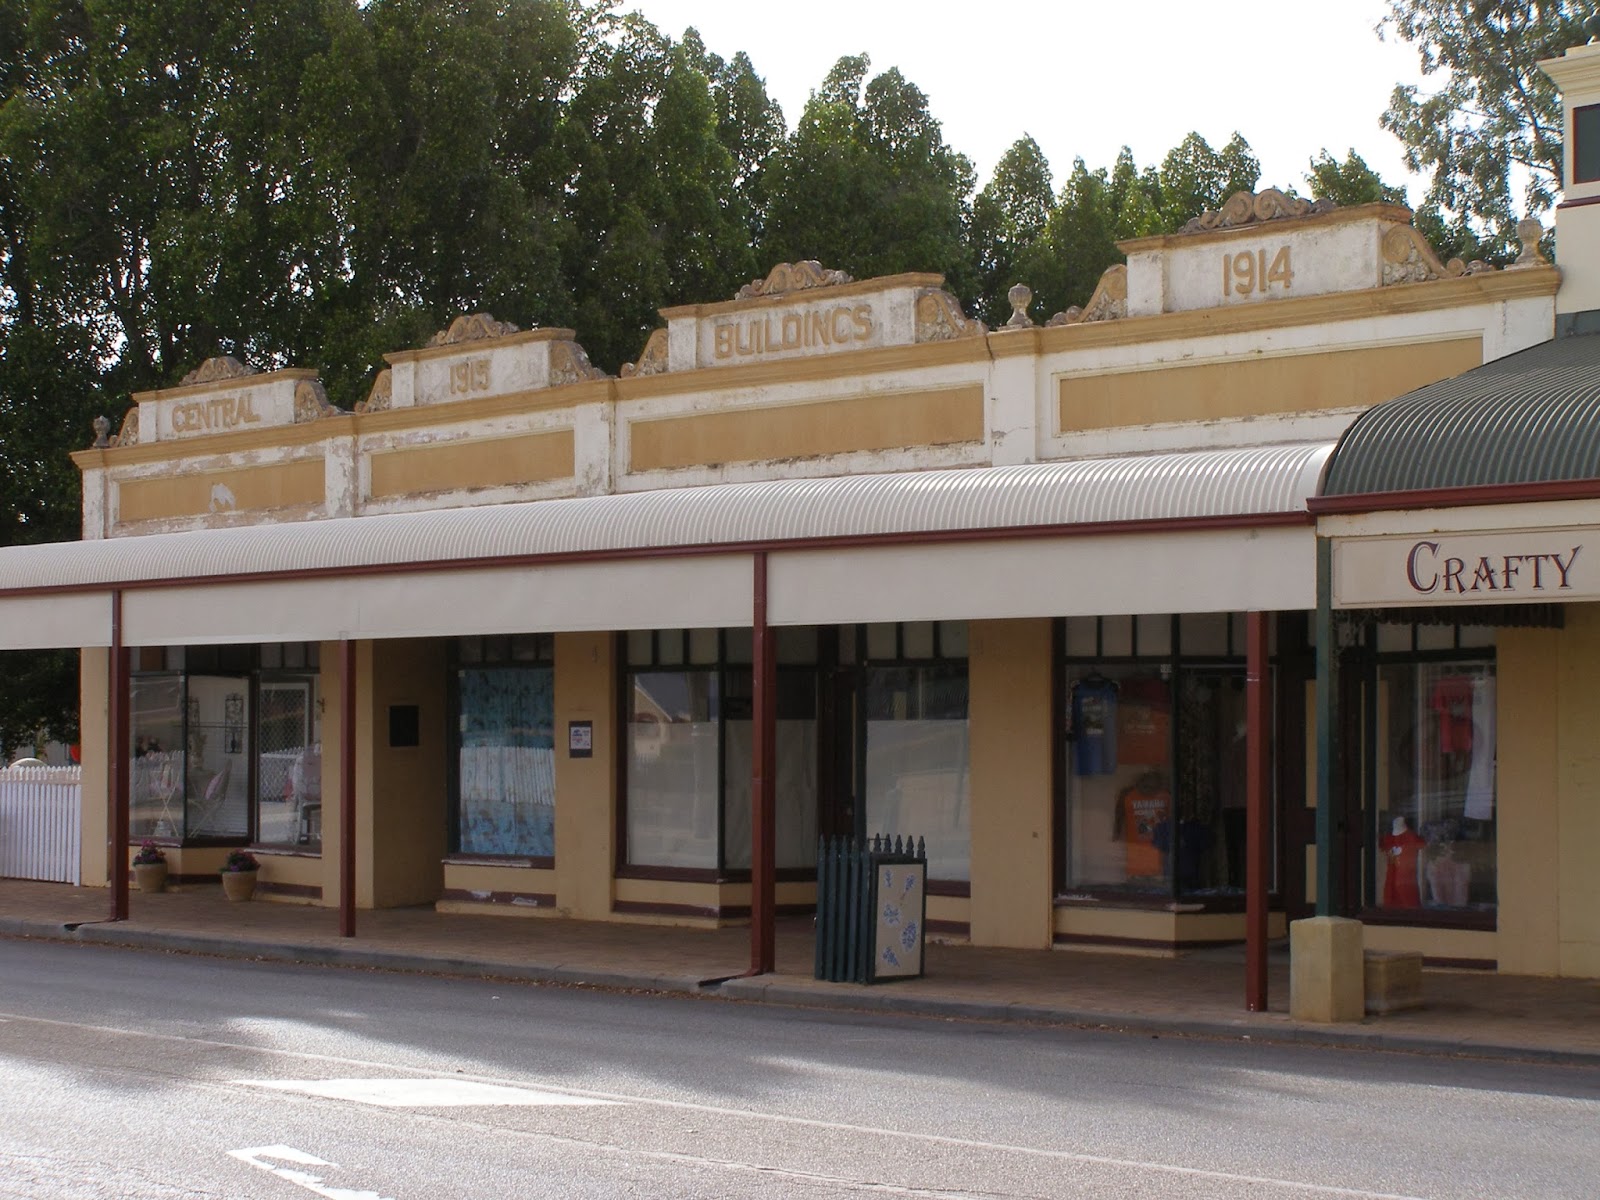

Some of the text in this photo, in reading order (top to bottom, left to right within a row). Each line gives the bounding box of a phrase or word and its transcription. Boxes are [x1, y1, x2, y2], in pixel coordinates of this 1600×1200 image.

[1222, 245, 1295, 297] 1914
[449, 360, 491, 395] 1915
[172, 393, 262, 432] CENTRAL
[1406, 541, 1583, 595] CRAFTY
